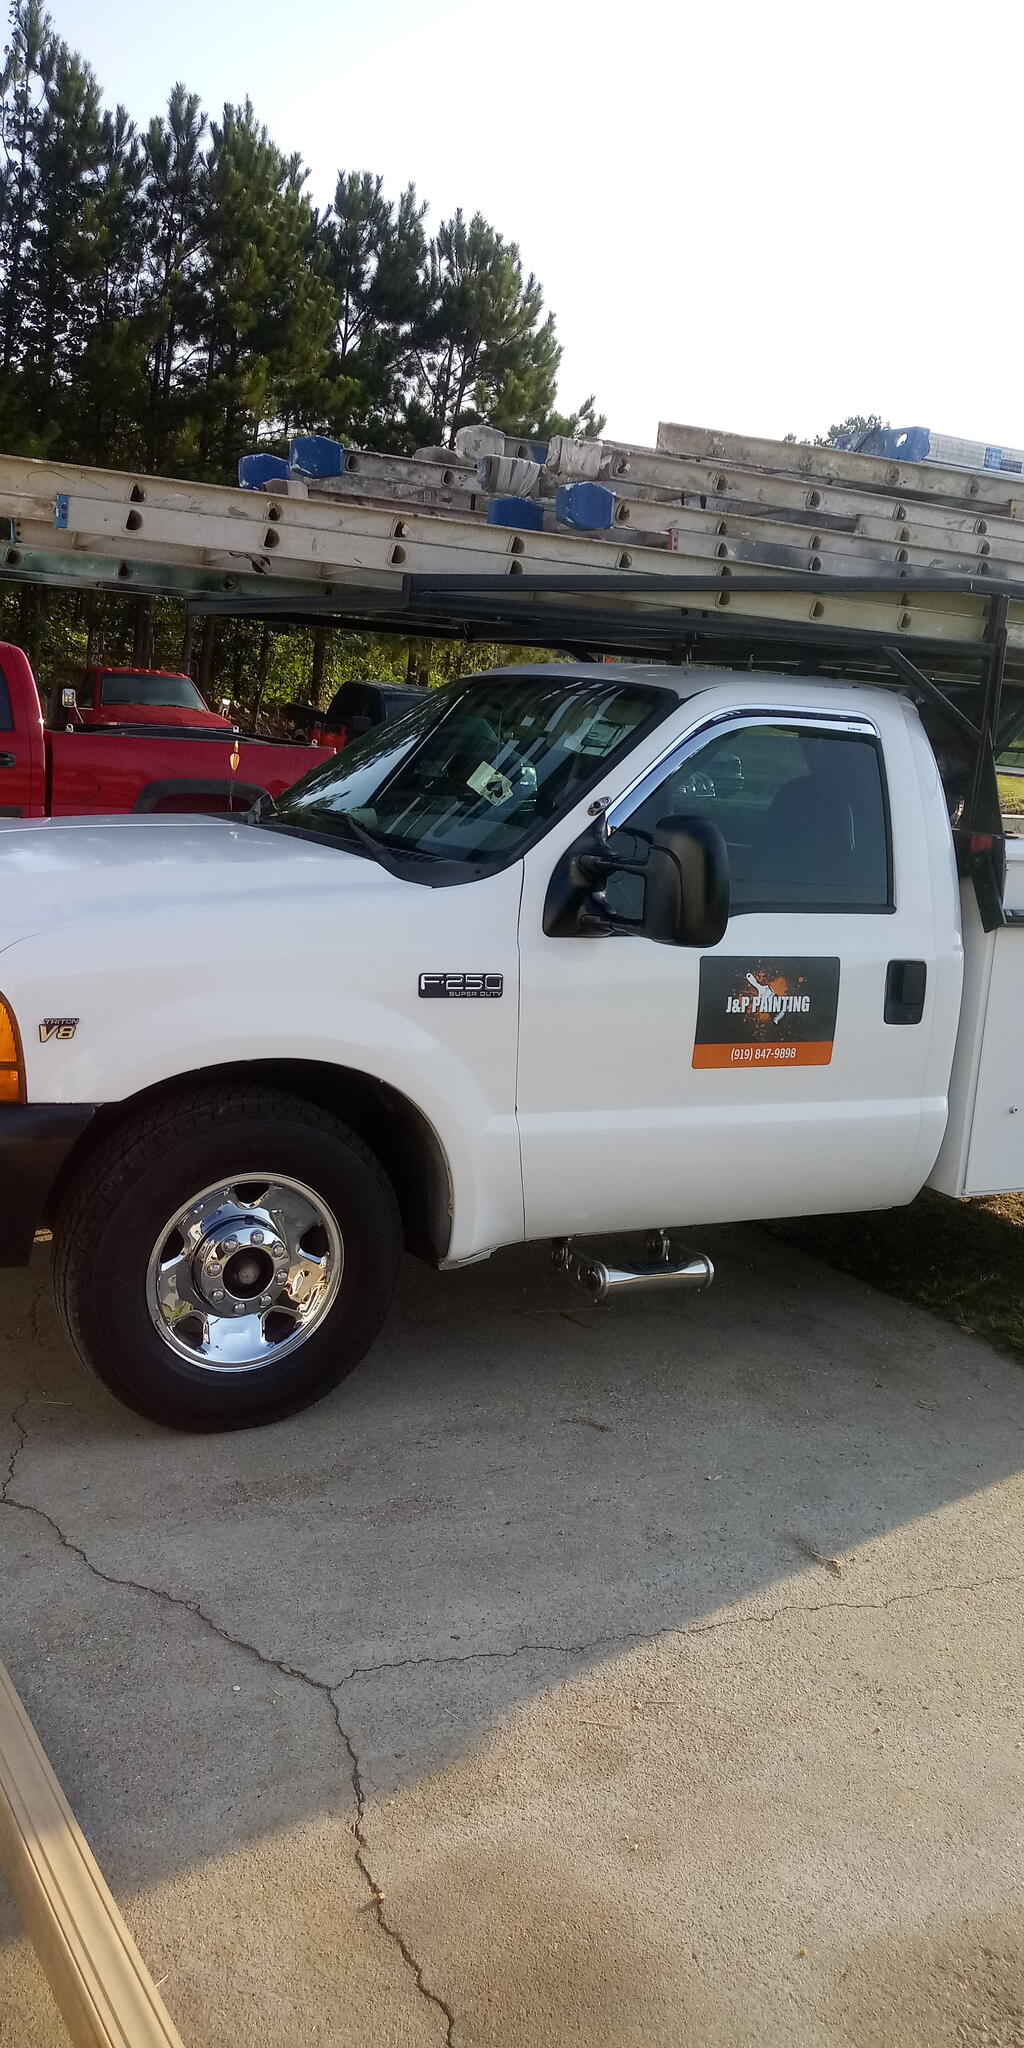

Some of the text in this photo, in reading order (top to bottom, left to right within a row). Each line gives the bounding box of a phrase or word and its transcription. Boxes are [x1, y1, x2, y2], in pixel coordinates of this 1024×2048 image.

[726, 995, 810, 1013] J&P PAINTING
[39, 1024, 76, 1043] V8
[731, 1047, 796, 1061] (919) 847-9898
